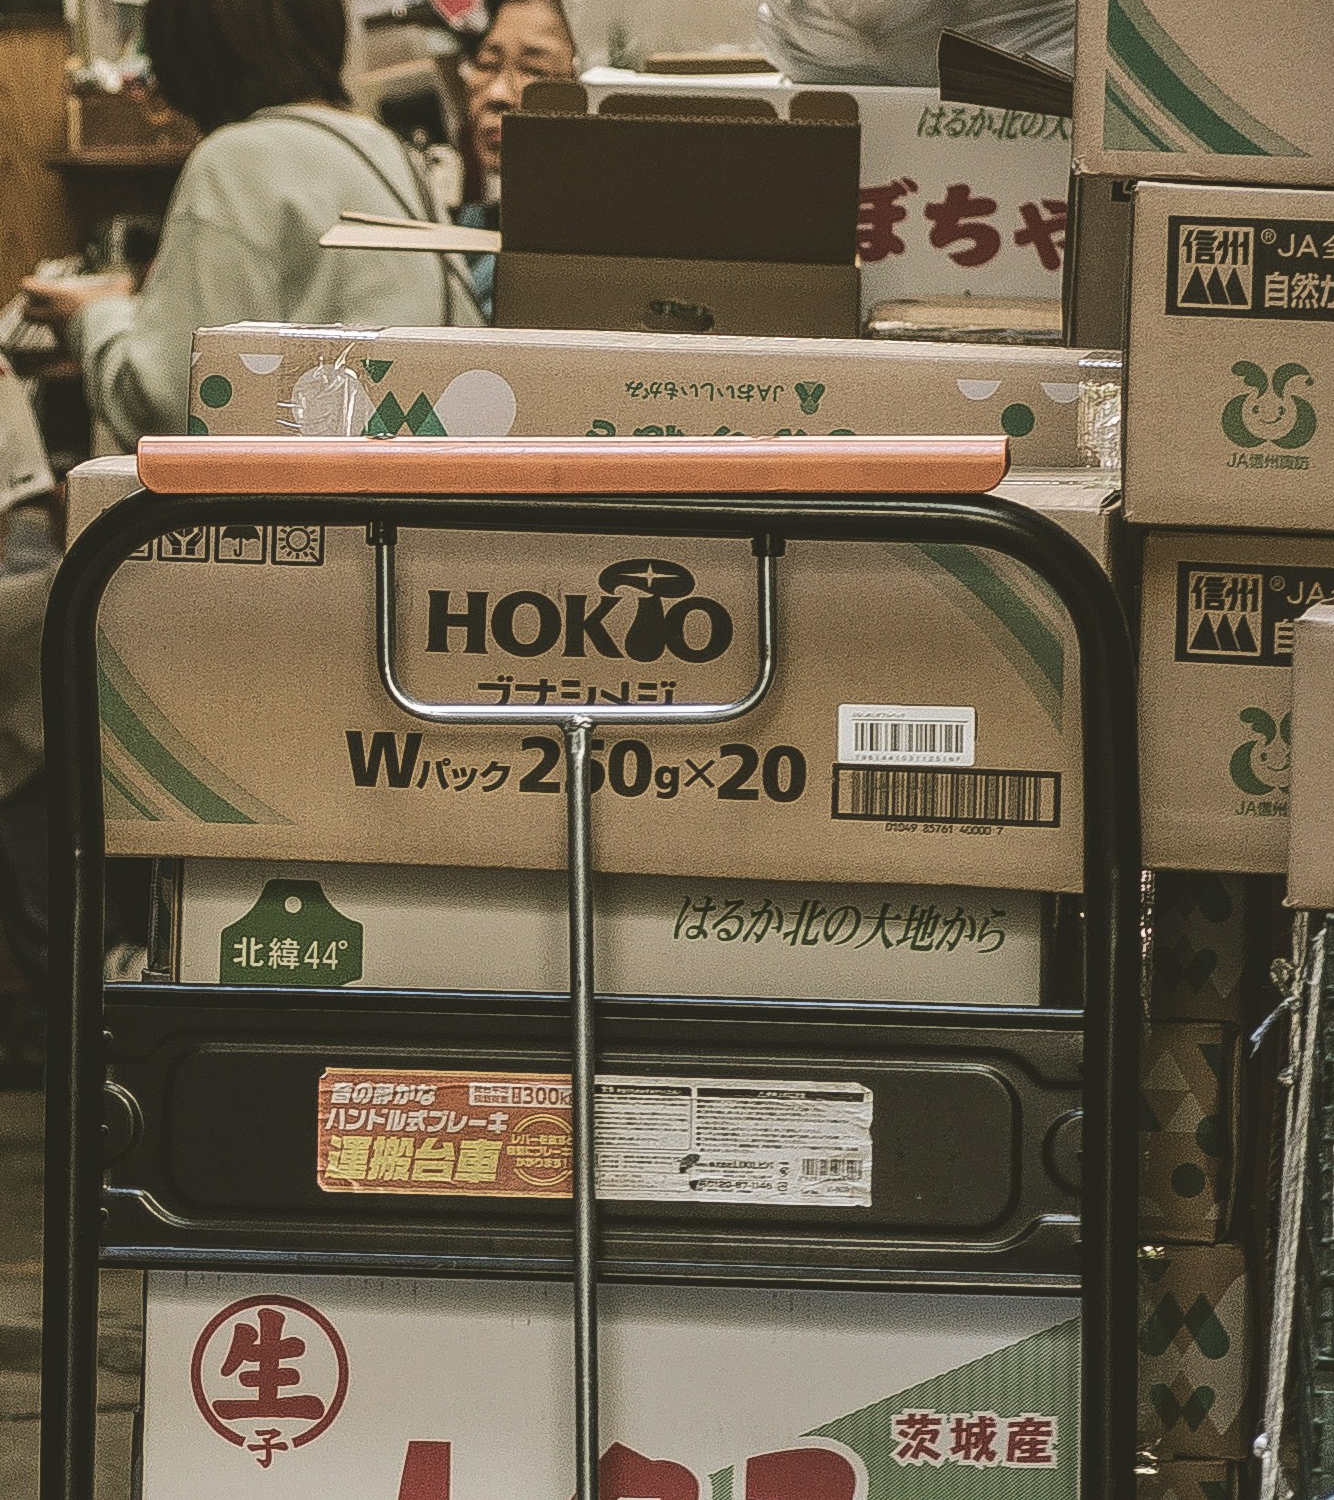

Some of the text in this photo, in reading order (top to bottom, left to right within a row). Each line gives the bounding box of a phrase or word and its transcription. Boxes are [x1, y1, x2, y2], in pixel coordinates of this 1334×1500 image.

[1180, 228, 1251, 267] 信州
[1188, 573, 1262, 614] 信州
[674, 895, 1007, 954] はるか北の大地から
[324, 1108, 510, 1134] ハンドル式ブレーキ
[324, 1135, 503, 1183] 運搬台車
[211, 1306, 325, 1423] 生
[894, 1412, 1056, 1467] 茨城産
